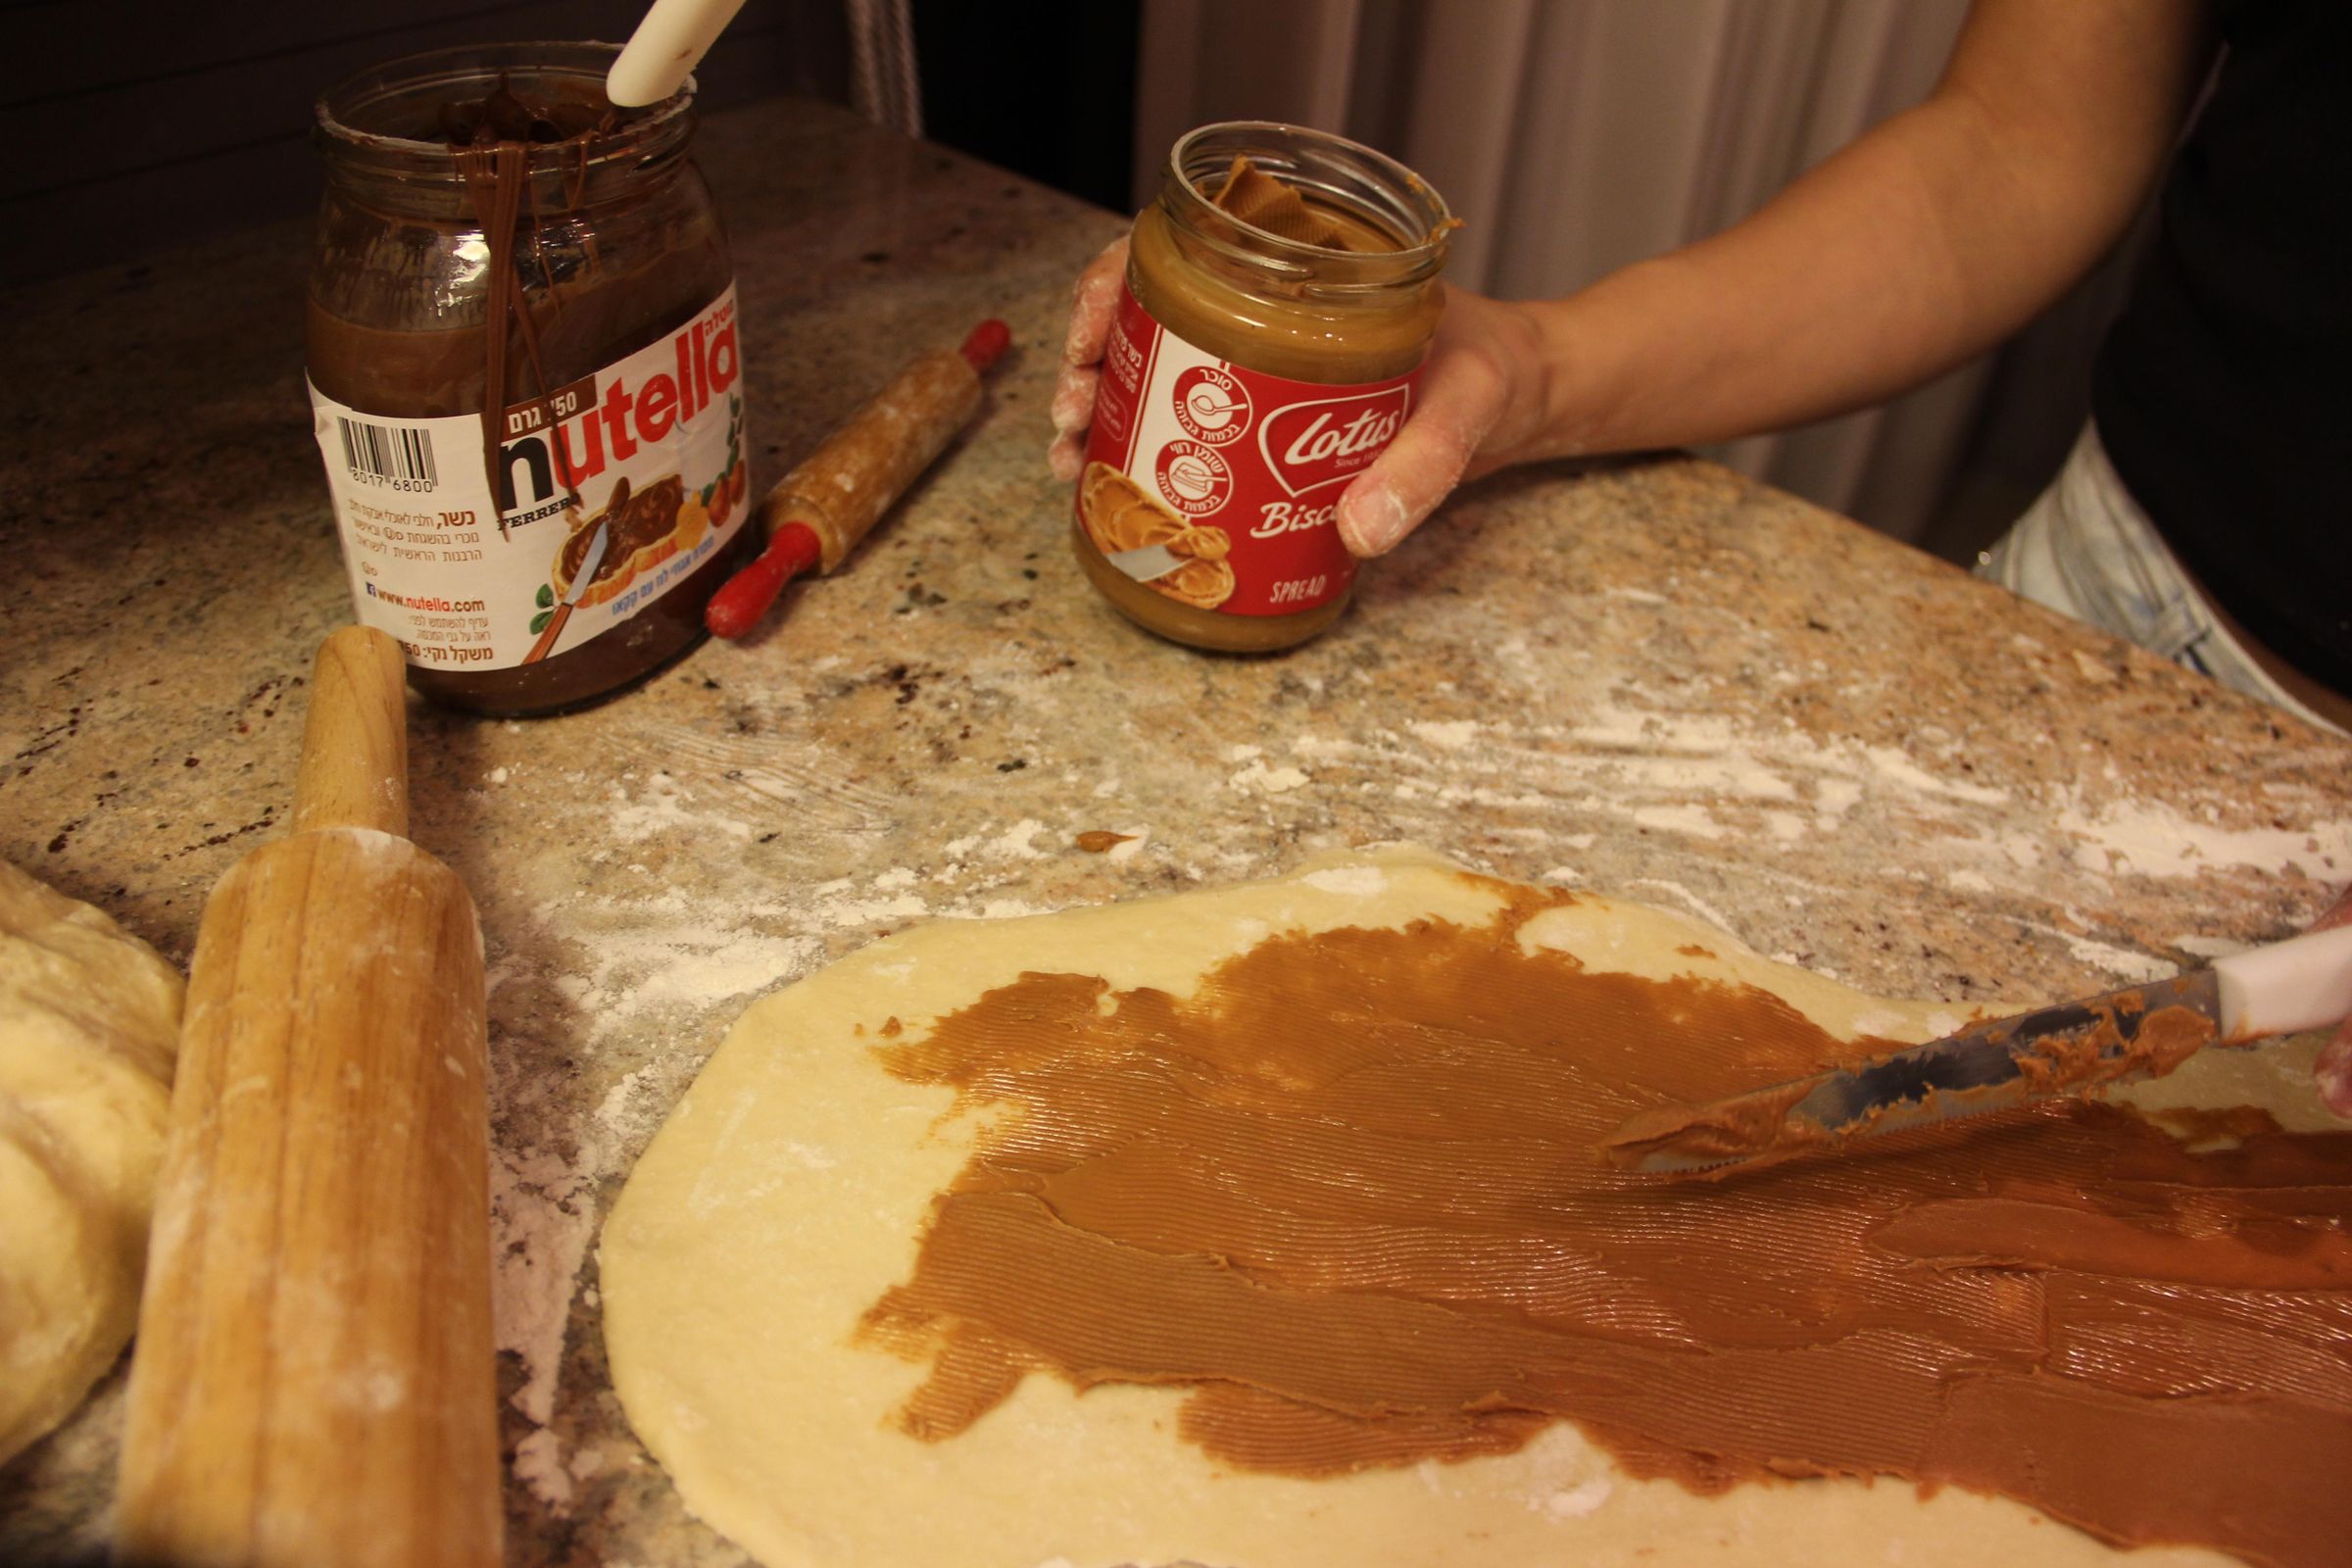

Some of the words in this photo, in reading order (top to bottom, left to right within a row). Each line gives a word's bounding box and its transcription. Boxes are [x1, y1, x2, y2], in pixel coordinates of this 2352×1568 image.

[1200, 368, 1233, 391] סוכר
[500, 319, 739, 512] nutella
[508, 406, 542, 434] גרם
[1174, 400, 1200, 437] גבוהה
[1200, 422, 1241, 442] בכמות
[1285, 408, 1400, 466] Lotus
[1193, 445, 1225, 474] שומן
[393, 478, 433, 493] 6800
[1183, 494, 1222, 513] בכמות
[436, 510, 476, 530] כשר,
[393, 547, 436, 562] הראשית
[443, 549, 483, 563] הרבנות
[377, 589, 485, 612] www.nutella.com
[1269, 574, 1328, 605] SPREAD
[449, 645, 494, 664] משקל
